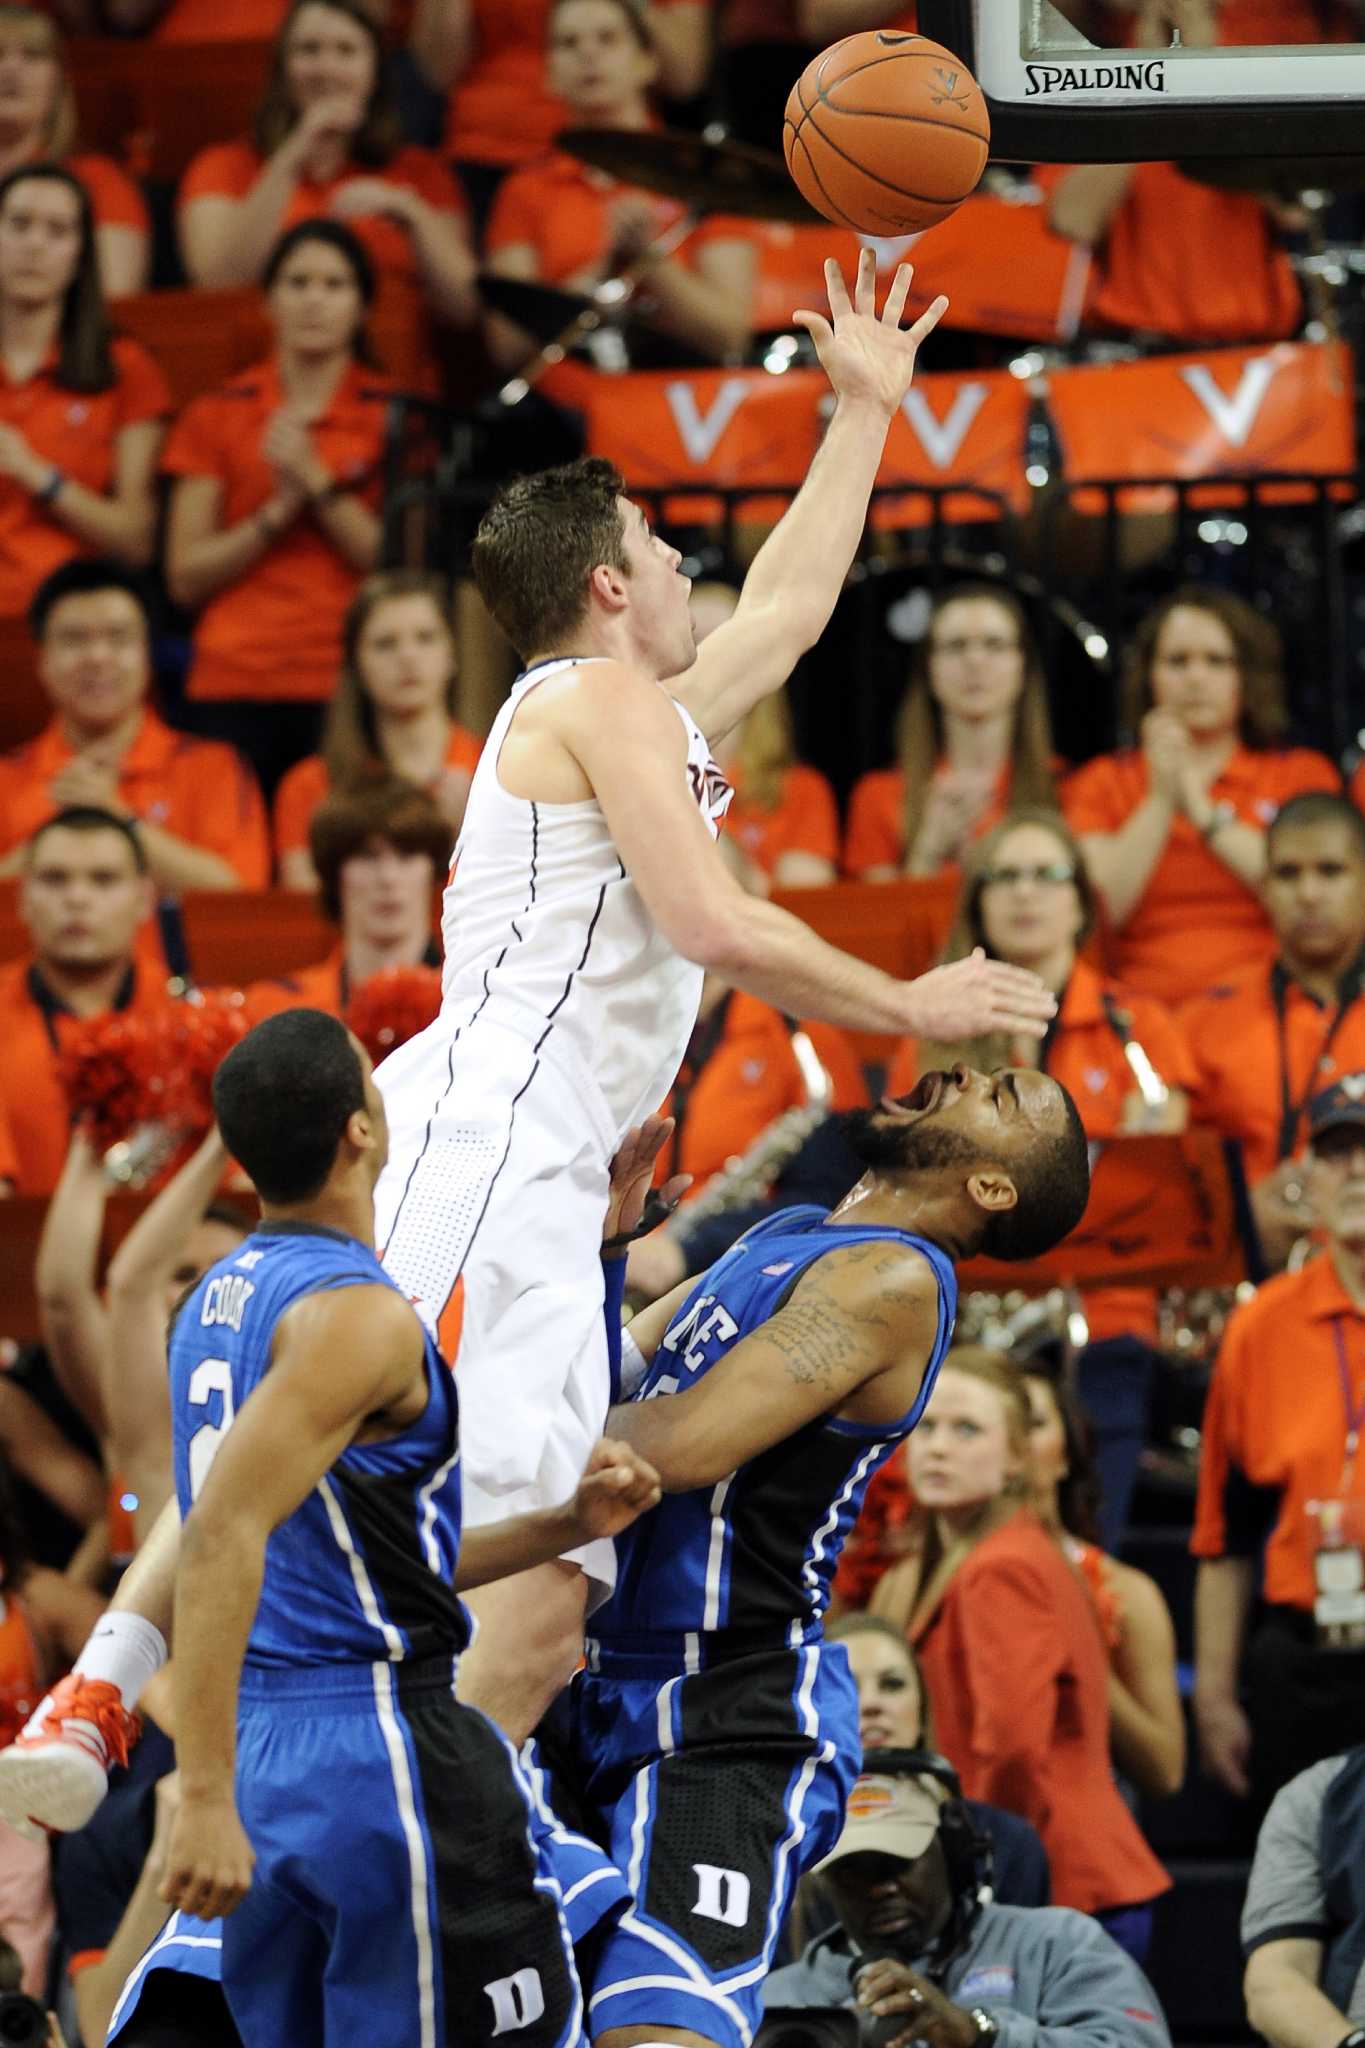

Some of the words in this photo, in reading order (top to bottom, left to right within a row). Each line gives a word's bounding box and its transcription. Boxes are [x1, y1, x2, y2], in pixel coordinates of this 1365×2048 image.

[1025, 60, 1165, 96] SPALDING
[665, 379, 750, 465] V
[902, 382, 990, 469] V
[1183, 357, 1279, 447] V
[201, 1274, 256, 1334] COOK
[187, 1358, 236, 1503] 2
[692, 1863, 750, 1928] D
[483, 1967, 546, 2037] D
